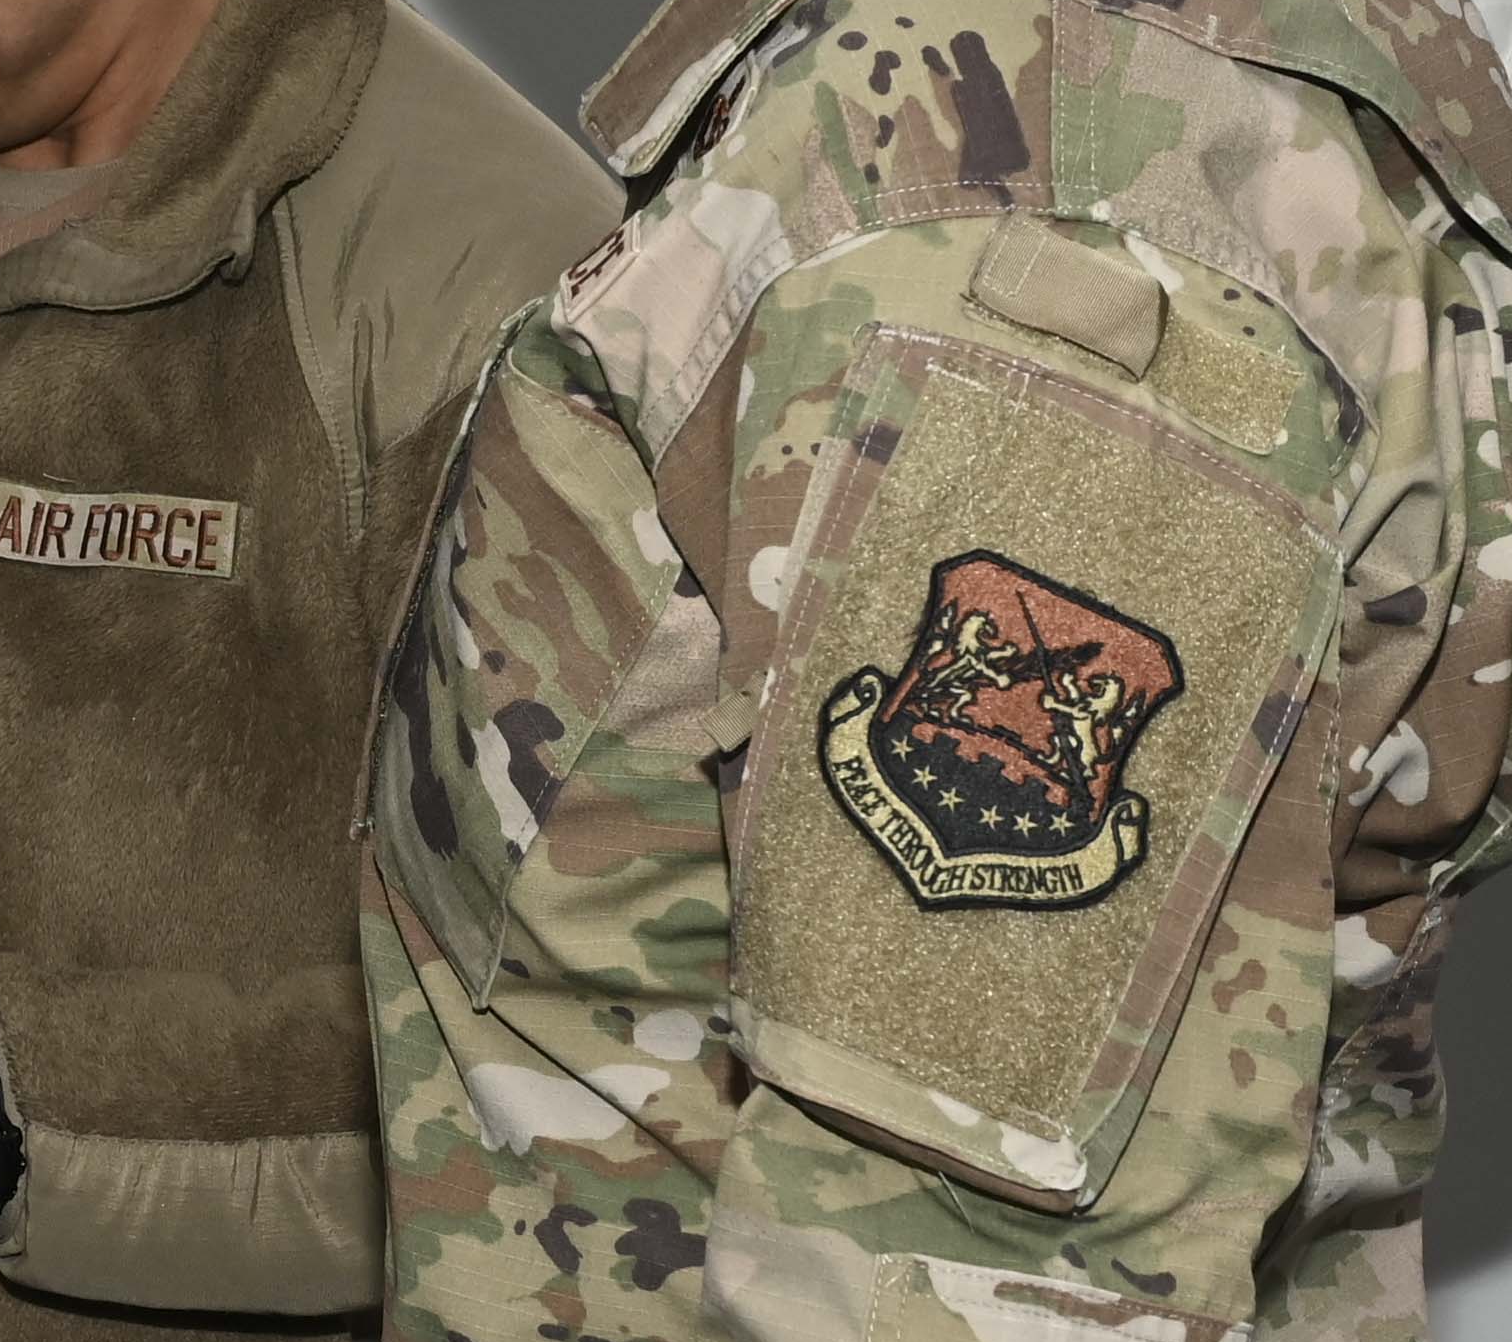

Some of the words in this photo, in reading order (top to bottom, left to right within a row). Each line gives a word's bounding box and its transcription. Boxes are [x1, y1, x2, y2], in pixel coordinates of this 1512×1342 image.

[79, 502, 223, 570] FORCE
[833, 755, 889, 817] PEACE
[876, 807, 967, 895] THROUGH
[969, 862, 1085, 894] STRENGTH
